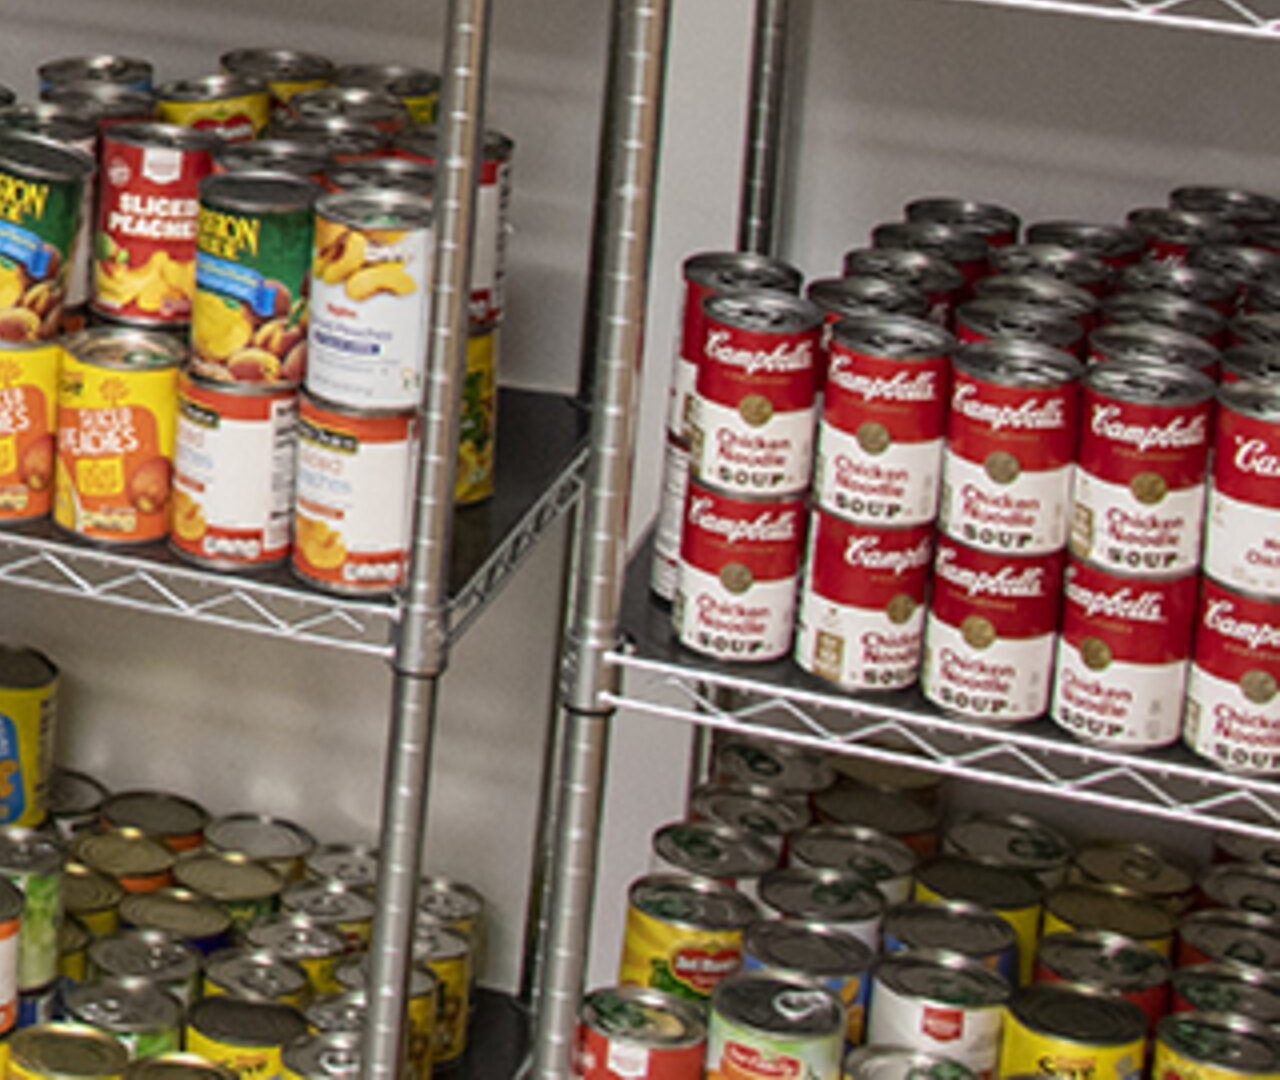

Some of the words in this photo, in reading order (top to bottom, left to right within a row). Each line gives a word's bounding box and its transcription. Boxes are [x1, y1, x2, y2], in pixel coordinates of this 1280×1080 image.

[120, 193, 198, 217] SLICED
[110, 214, 198, 239] PEACHE
[715, 427, 792, 453] Chicken
[717, 447, 787, 469] Noodle
[834, 454, 909, 482] Chicken
[718, 467, 786, 487] SOUP
[835, 476, 905, 499] Noodle
[835, 494, 902, 517] SOUP
[961, 483, 1040, 512] Chicken
[1106, 506, 1184, 530] Chicken
[964, 524, 1033, 548] SOUP
[1107, 547, 1178, 568] SOUP
[696, 593, 771, 619] Chicken
[699, 632, 765, 654] SOUP
[940, 647, 1017, 677] Chicken
[1061, 671, 1133, 703] Chicken
[942, 688, 1010, 713] SOUP
[1061, 708, 1125, 737] SOUP
